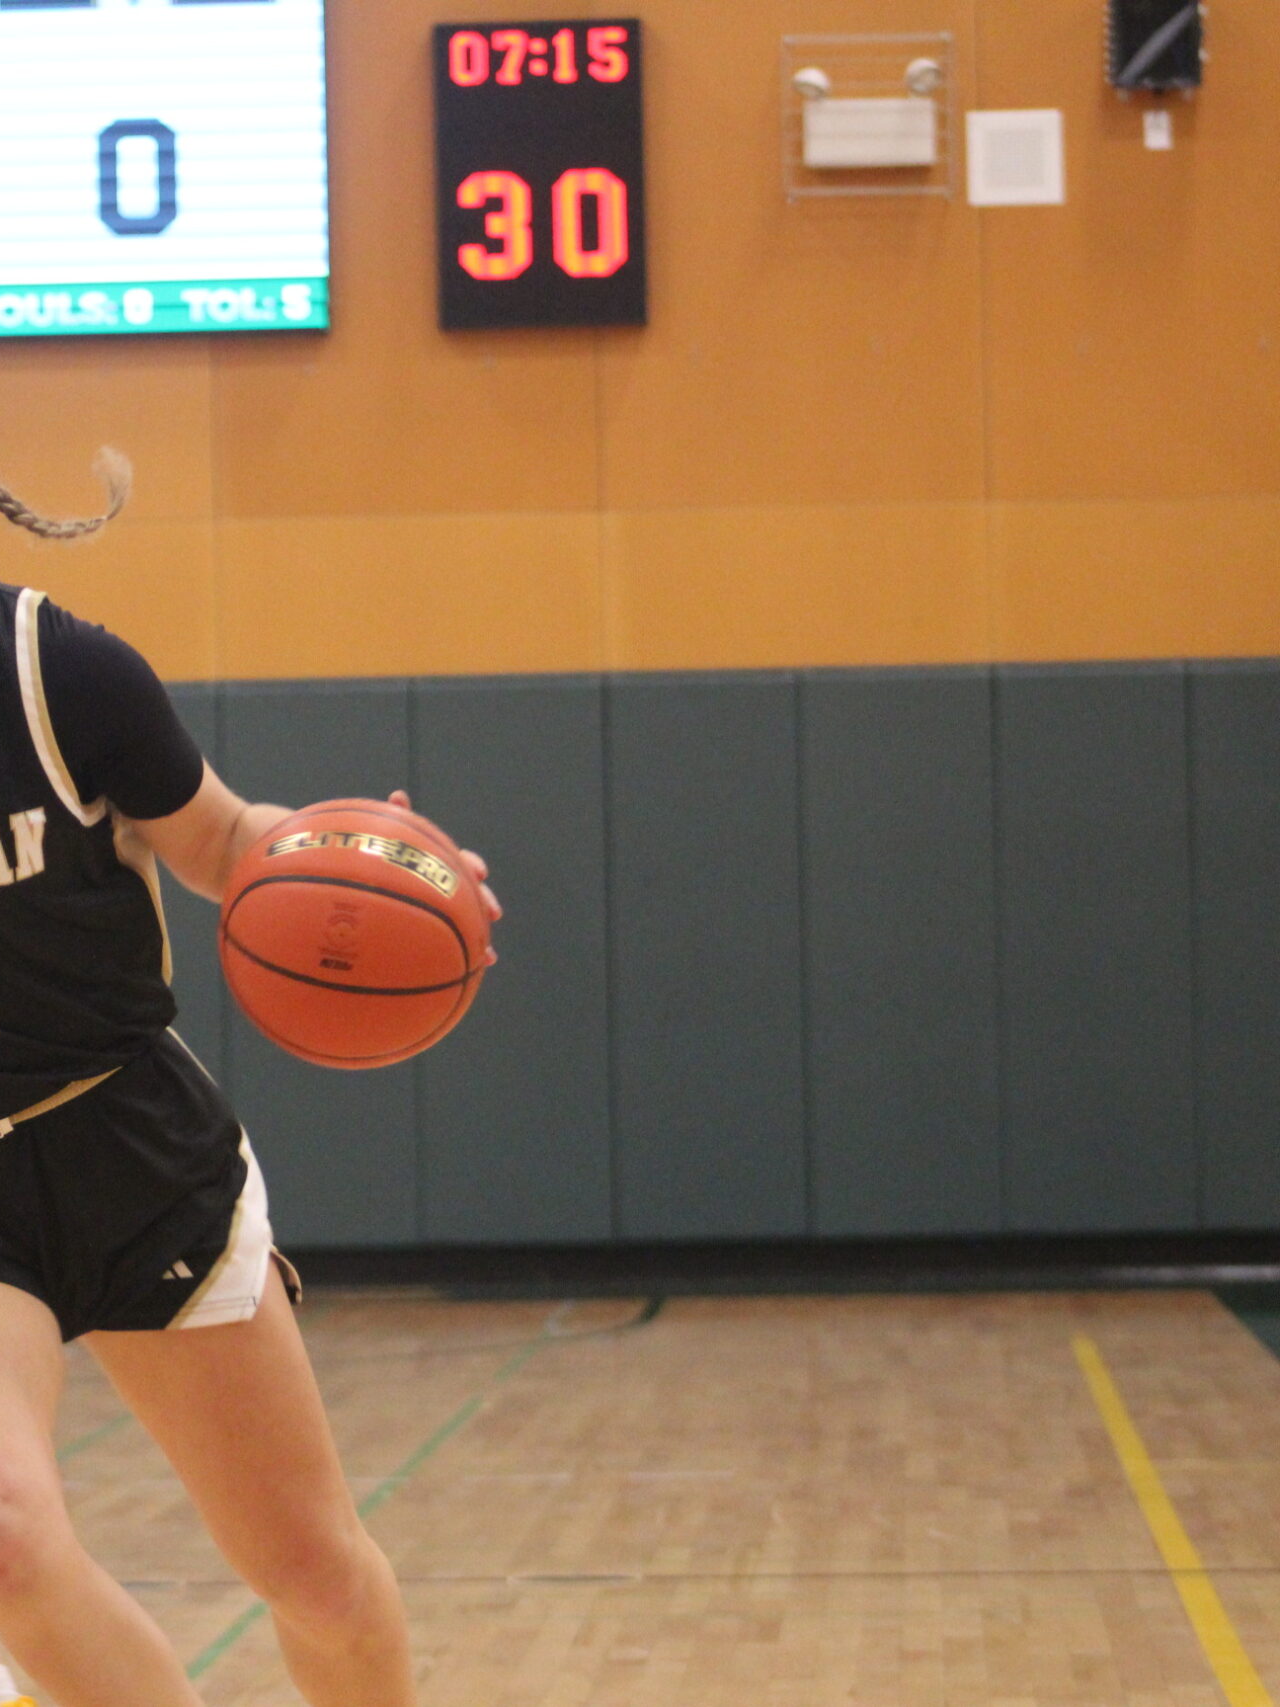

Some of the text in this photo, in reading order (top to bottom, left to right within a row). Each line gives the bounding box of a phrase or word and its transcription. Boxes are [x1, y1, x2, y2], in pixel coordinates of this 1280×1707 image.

[449, 26, 629, 87] 07:15
[98, 118, 177, 235] 0
[456, 167, 629, 280] 30
[179, 287, 276, 324] TOL:
